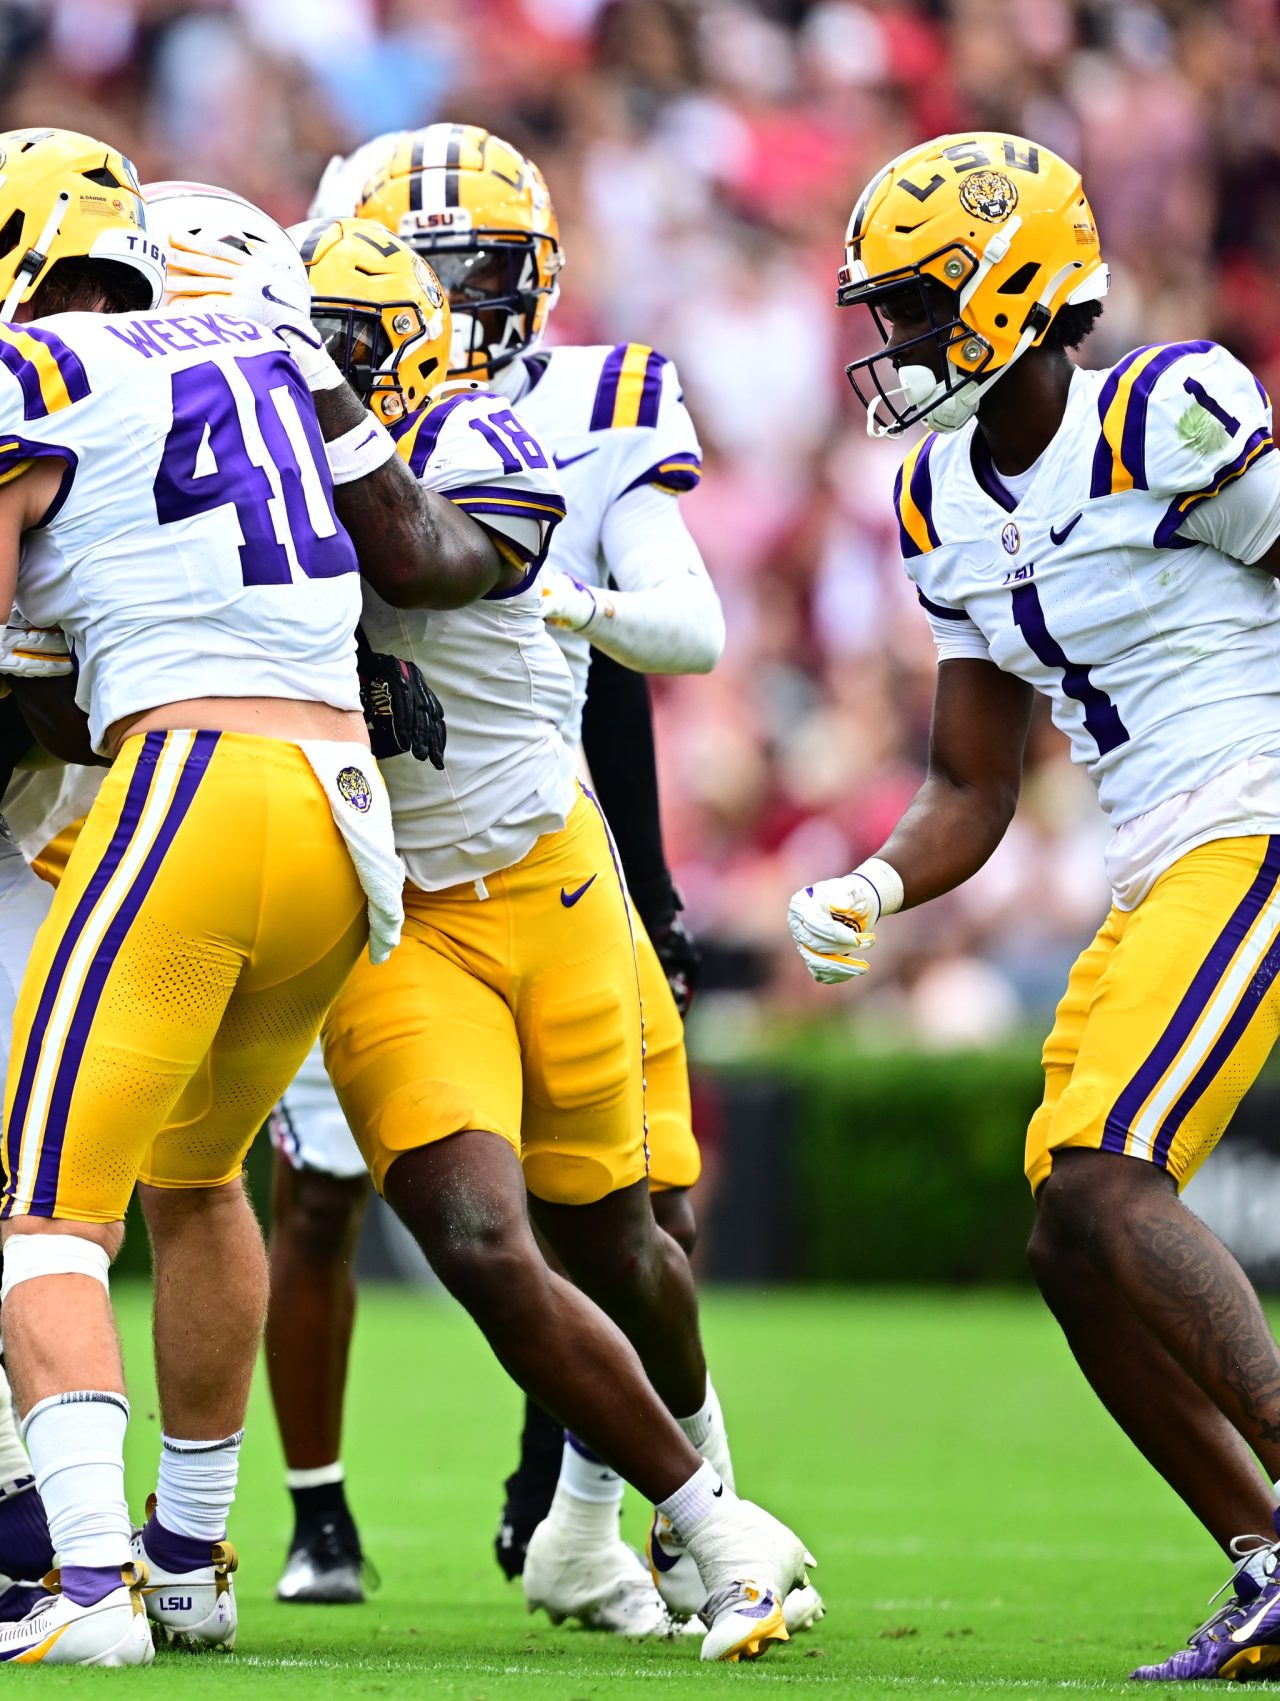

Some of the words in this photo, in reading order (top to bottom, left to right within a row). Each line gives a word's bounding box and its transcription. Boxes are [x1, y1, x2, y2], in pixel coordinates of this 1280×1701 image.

[897, 140, 1040, 203] LSU
[416, 213, 454, 229] LSU
[104, 313, 263, 358] WEEKS
[1183, 376, 1241, 438] 1
[153, 350, 361, 587] 40
[469, 409, 549, 476] 18
[1002, 562, 1035, 586] LSU
[1010, 581, 1131, 757] 1
[160, 1597, 192, 1611] LSU
